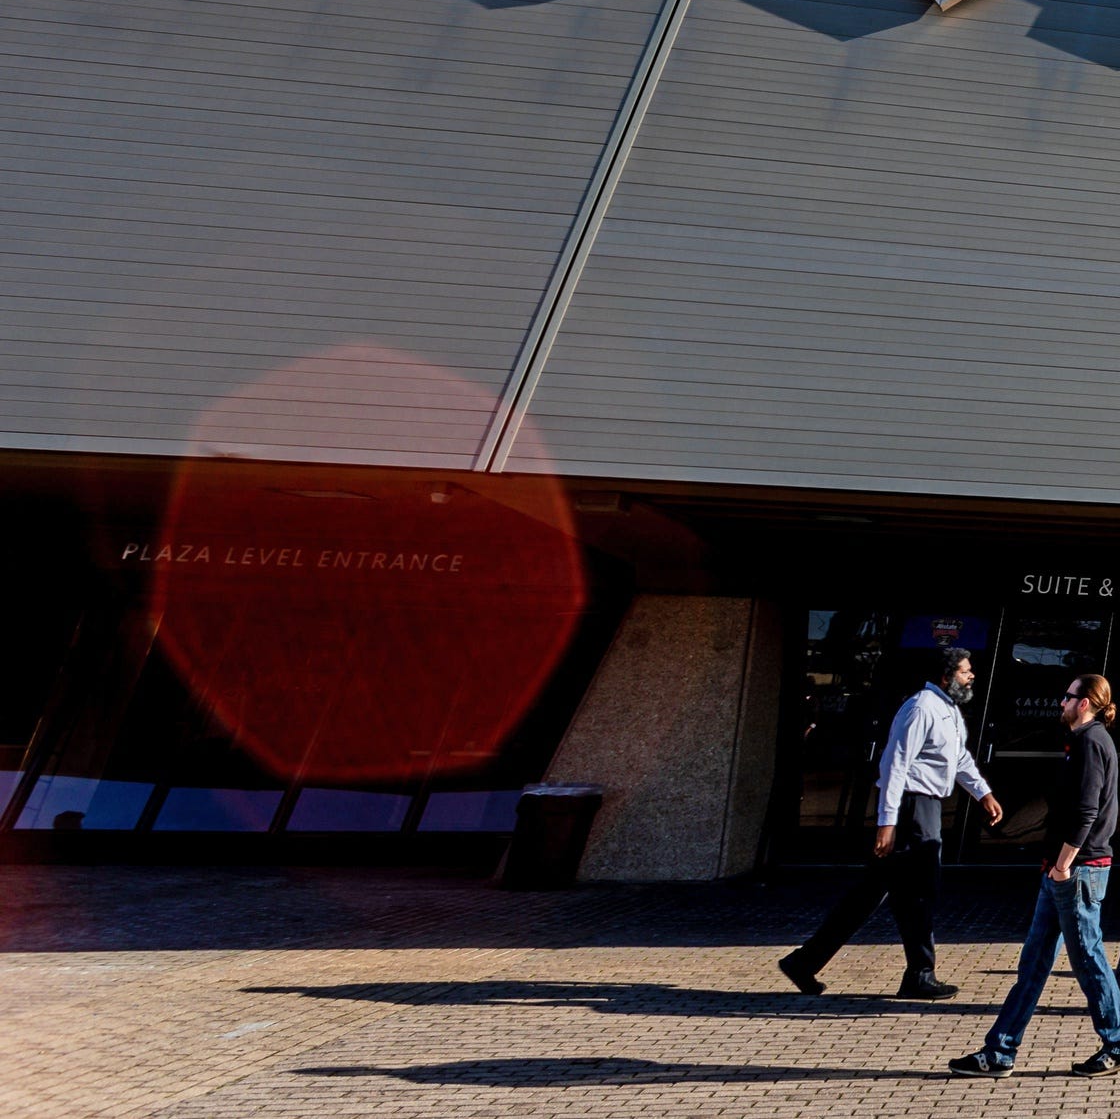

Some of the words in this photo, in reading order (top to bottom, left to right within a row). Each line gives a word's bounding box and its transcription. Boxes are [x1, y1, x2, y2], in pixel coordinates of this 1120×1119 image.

[121, 542, 211, 563] PLAZA
[223, 546, 304, 568] LEVEL
[317, 549, 464, 573] ENTRANCE
[1021, 574, 1091, 596] SUITE
[1098, 578, 1114, 597] &
